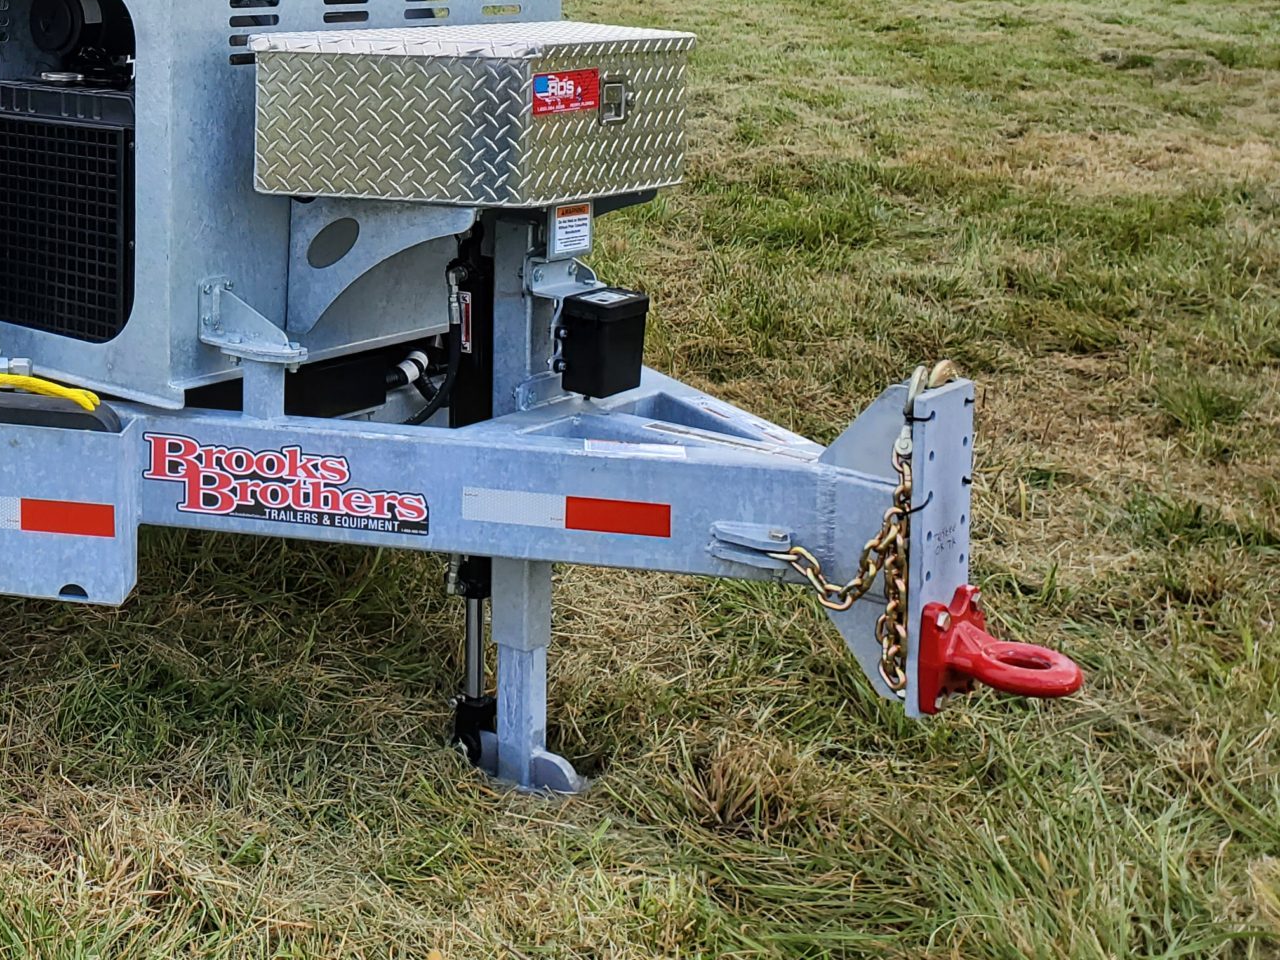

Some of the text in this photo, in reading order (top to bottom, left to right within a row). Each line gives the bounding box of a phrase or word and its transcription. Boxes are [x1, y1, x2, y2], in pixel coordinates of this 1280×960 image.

[143, 433, 350, 484] Brooks
[178, 464, 428, 522] Brothers
[264, 508, 318, 525] TRAILERS
[322, 515, 331, 525] &
[334, 515, 400, 532] EQUIPMENT
